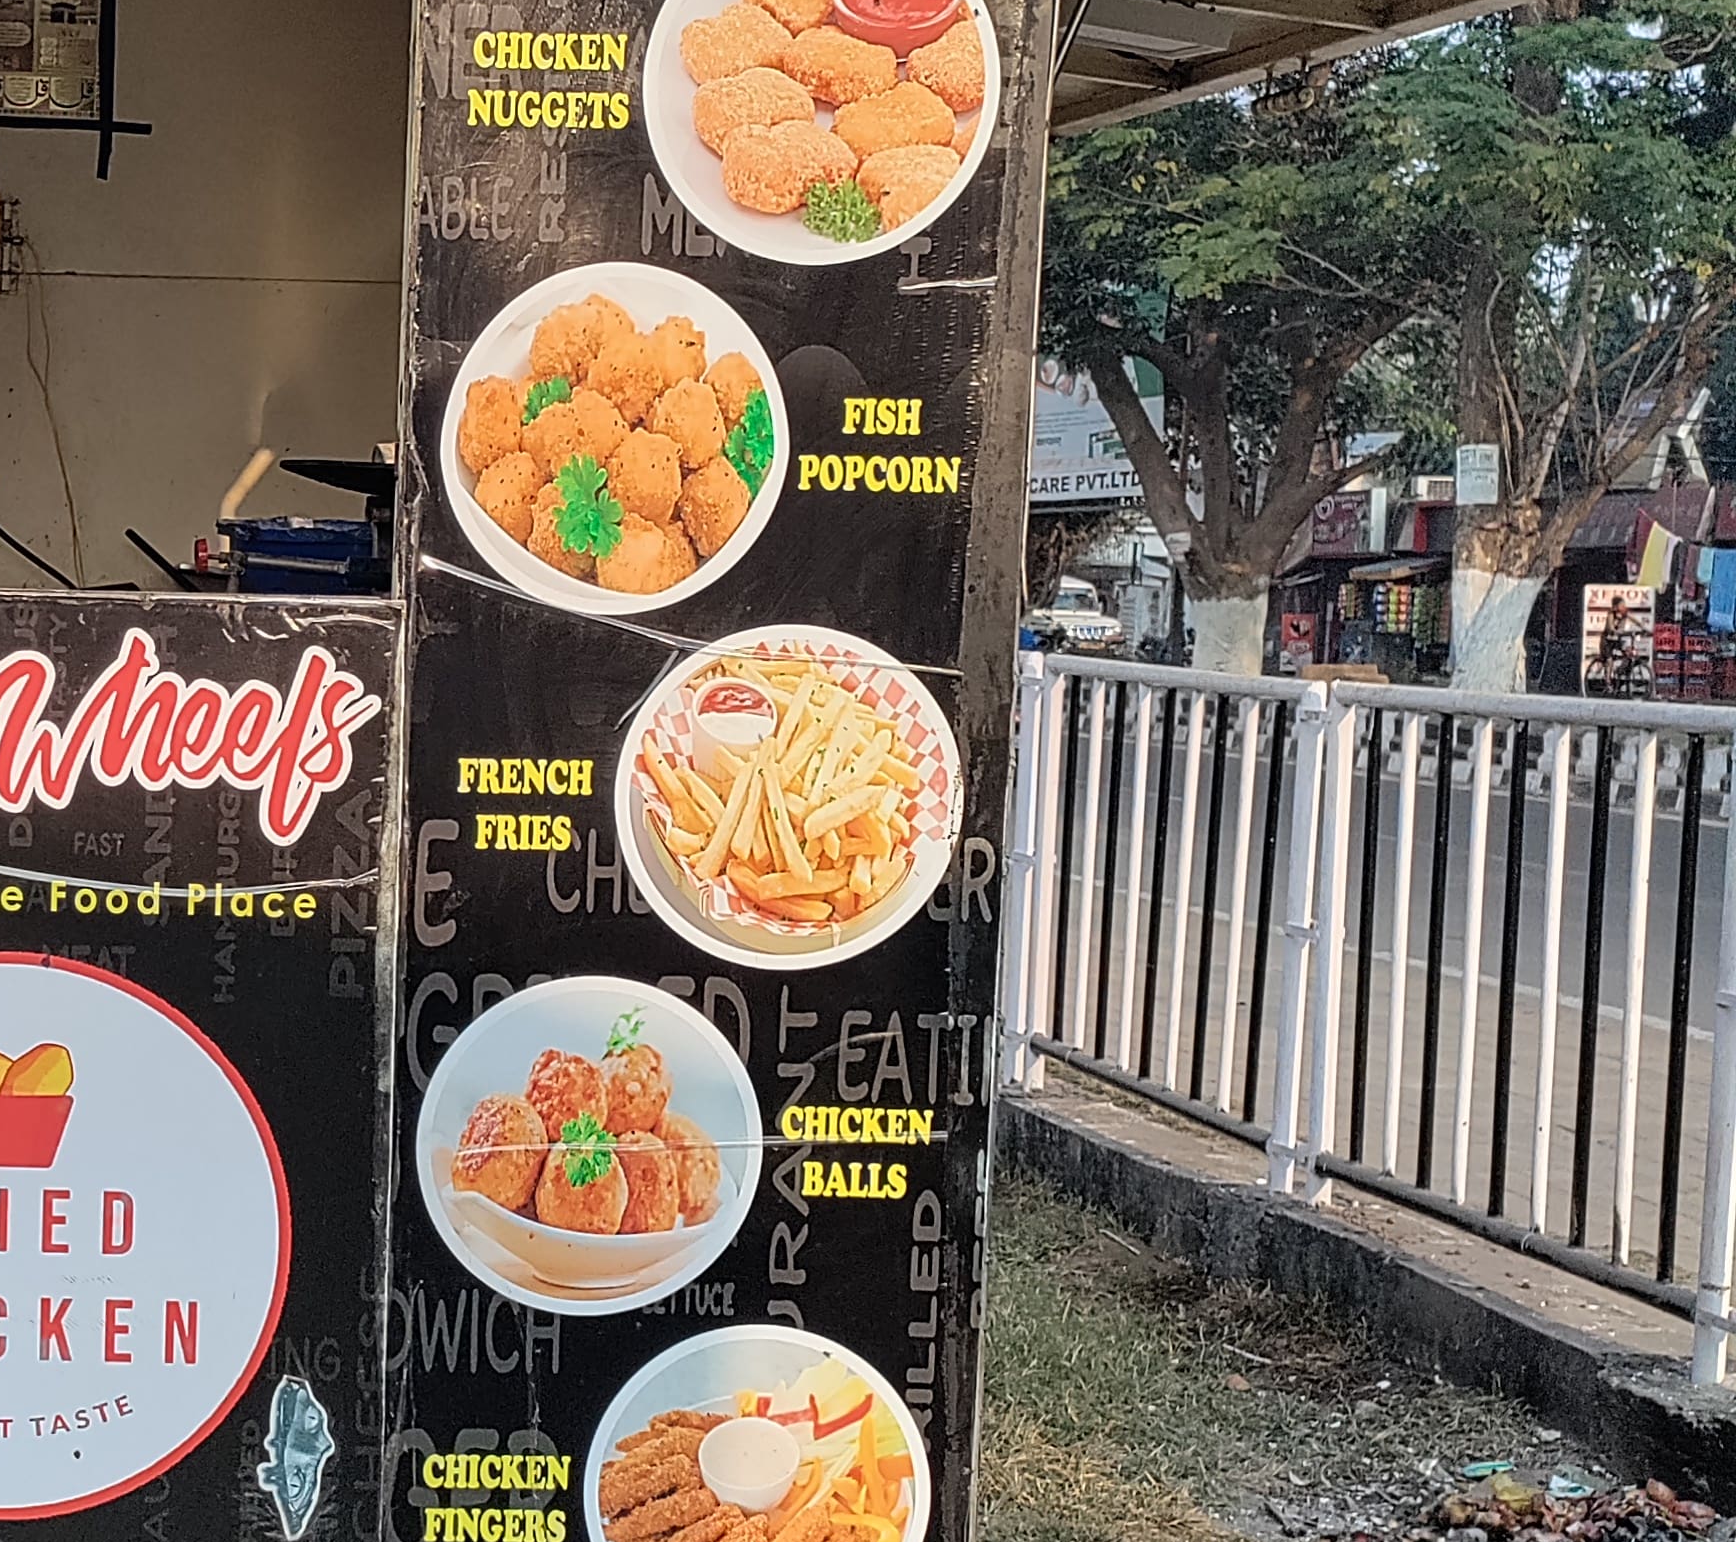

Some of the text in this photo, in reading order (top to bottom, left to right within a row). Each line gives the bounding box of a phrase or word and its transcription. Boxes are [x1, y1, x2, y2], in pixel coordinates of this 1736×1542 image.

[471, 30, 630, 73] CHICKEN
[465, 88, 631, 131] NUGGETS
[842, 396, 923, 437] FISH
[798, 454, 963, 495] POPCORN
[457, 756, 595, 798] FRENCH
[73, 830, 126, 857] FAST
[473, 812, 574, 853] FRIES
[48, 878, 162, 916] Food
[186, 881, 318, 920] Place
[327, 788, 374, 998] PIZZA
[779, 1106, 935, 1147] CHICKEN
[800, 1160, 909, 1201] BALLS
[29, 1393, 136, 1439] TASTE
[421, 1452, 573, 1493] CHICKEN
